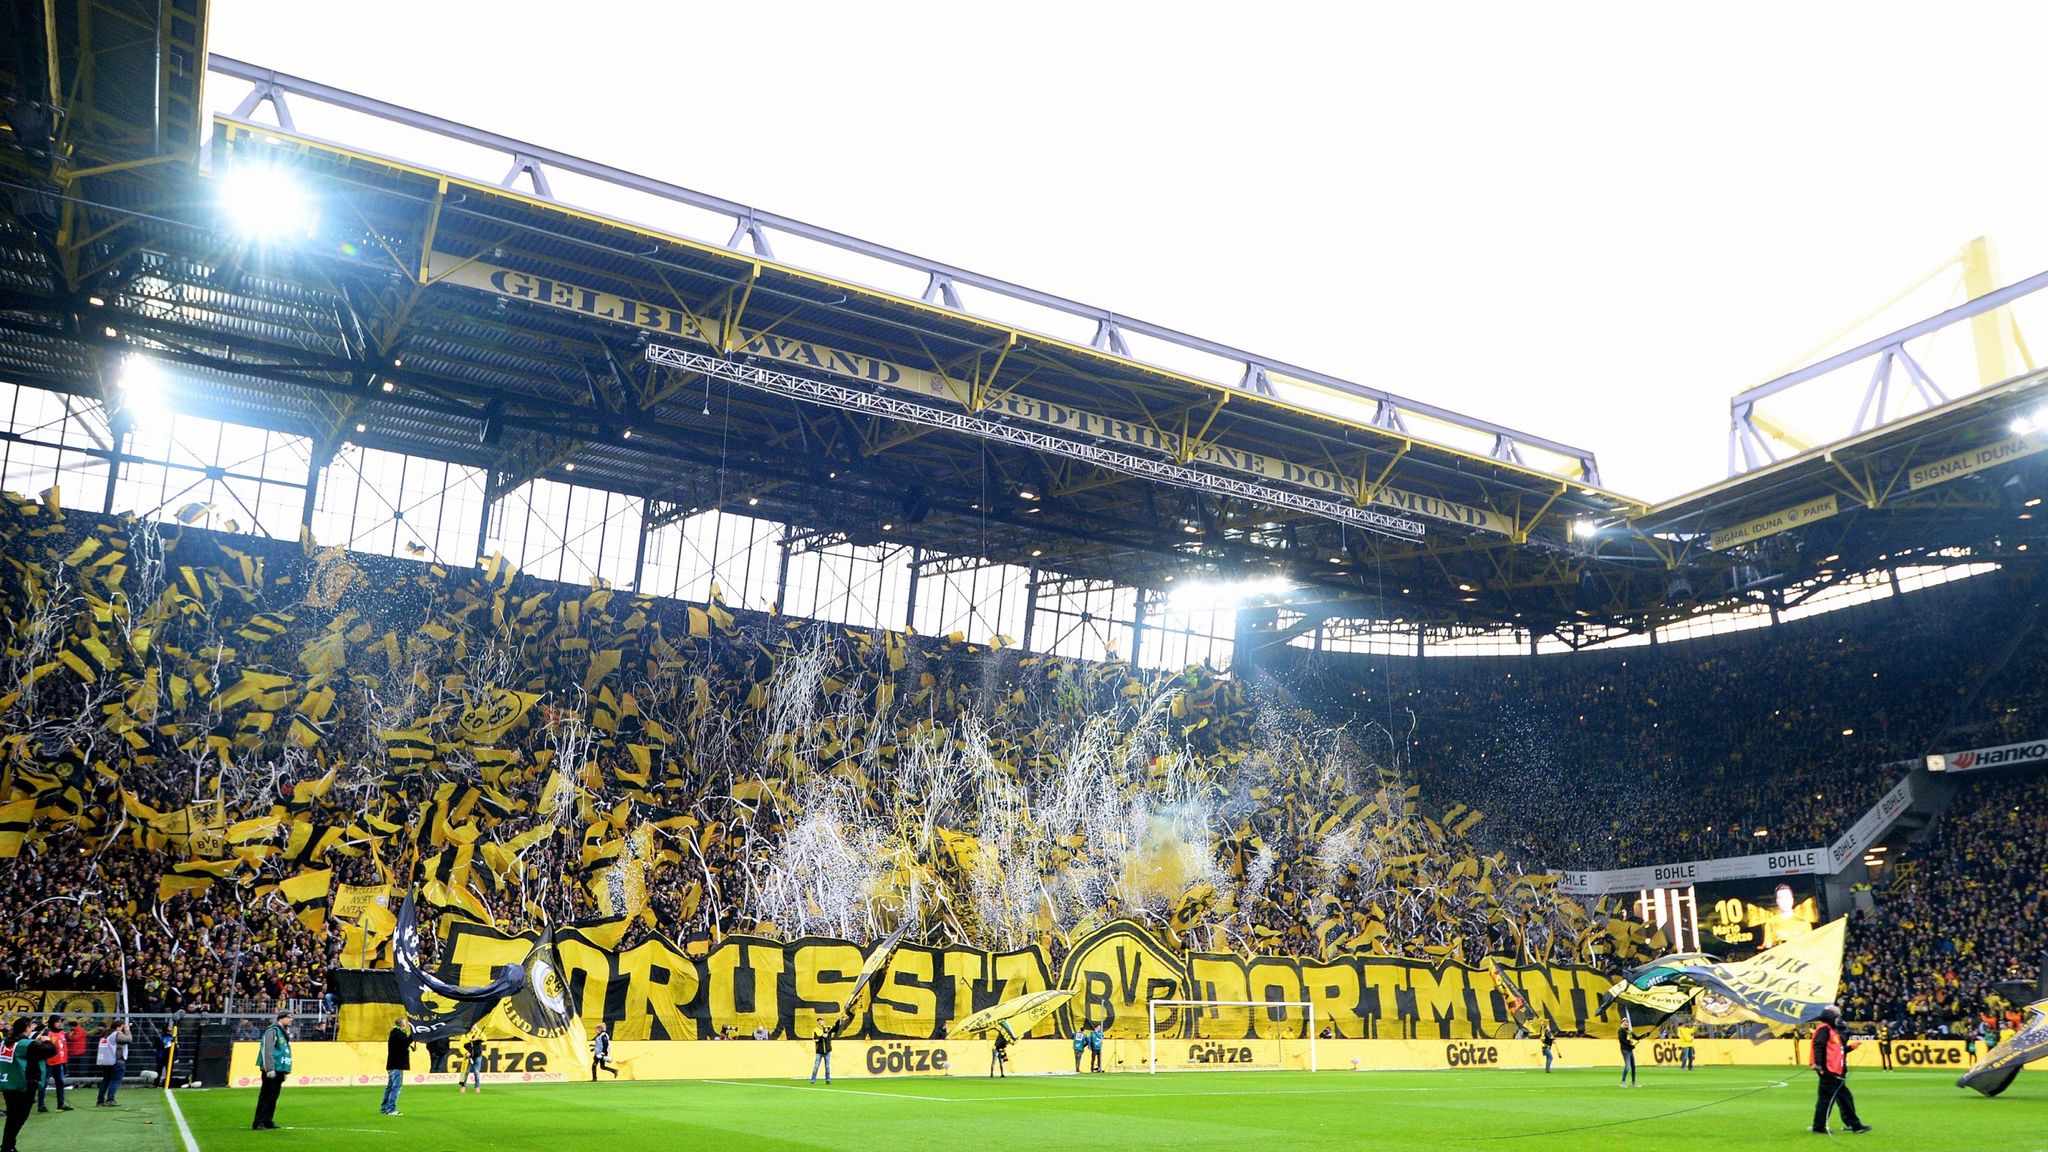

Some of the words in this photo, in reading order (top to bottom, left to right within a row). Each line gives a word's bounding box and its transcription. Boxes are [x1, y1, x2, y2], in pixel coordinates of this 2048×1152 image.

[490, 270, 702, 338] GELBE
[738, 327, 900, 384] WAND
[1280, 461, 1488, 527] DORTMUND
[1914, 458, 1972, 484] SIGNAL
[1976, 440, 2029, 465] IDUNA
[1714, 528, 1751, 545] SIGNAL
[1752, 517, 1783, 534] IDUNA
[1803, 502, 1832, 517] PARK
[1975, 744, 2048, 766] Hanko
[1881, 788, 1905, 814] BOHLE
[197, 836, 219, 849] BVB
[1833, 834, 1857, 860] BOHLE
[1655, 865, 1696, 880] BOHLE
[1768, 853, 1816, 869] BOHLE
[1560, 874, 1588, 886] OHLE
[1714, 898, 1744, 925] 10
[1712, 923, 1741, 936] Mario
[1083, 945, 1179, 1033] BVB
[1192, 957, 1625, 1040] DORTMUND
[446, 1046, 548, 1073] Gtze
[866, 1042, 949, 1075] Götze
[1188, 1041, 1253, 1064] Götze
[1446, 1041, 1498, 1067] Götze
[1653, 1041, 1696, 1064] Göt
[1895, 1042, 1962, 1066] Götze
[311, 1075, 344, 1083] POCO
[426, 1072, 458, 1081] POCO
[481, 1072, 511, 1081] POCO
[532, 1071, 562, 1080] POCO
